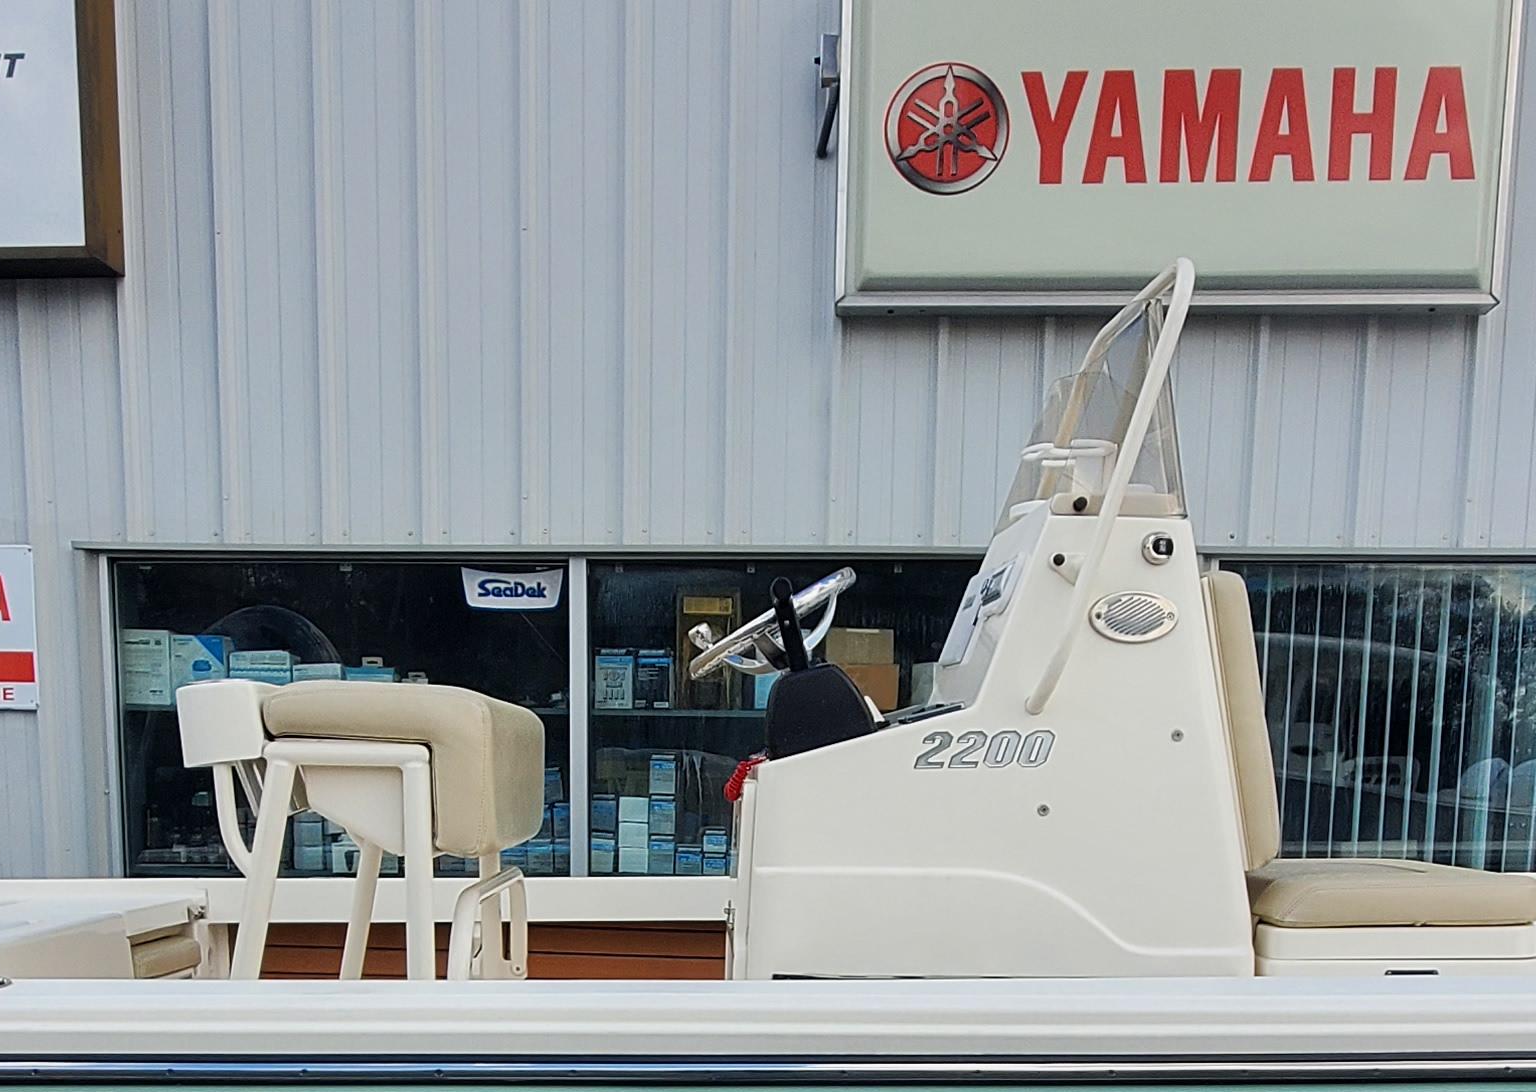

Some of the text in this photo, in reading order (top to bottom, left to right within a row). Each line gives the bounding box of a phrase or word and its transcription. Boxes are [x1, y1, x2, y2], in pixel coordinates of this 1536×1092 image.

[1020, 67, 1476, 184] YAMAHA
[477, 578, 547, 598] SeaDek
[913, 730, 1056, 769] 2200
